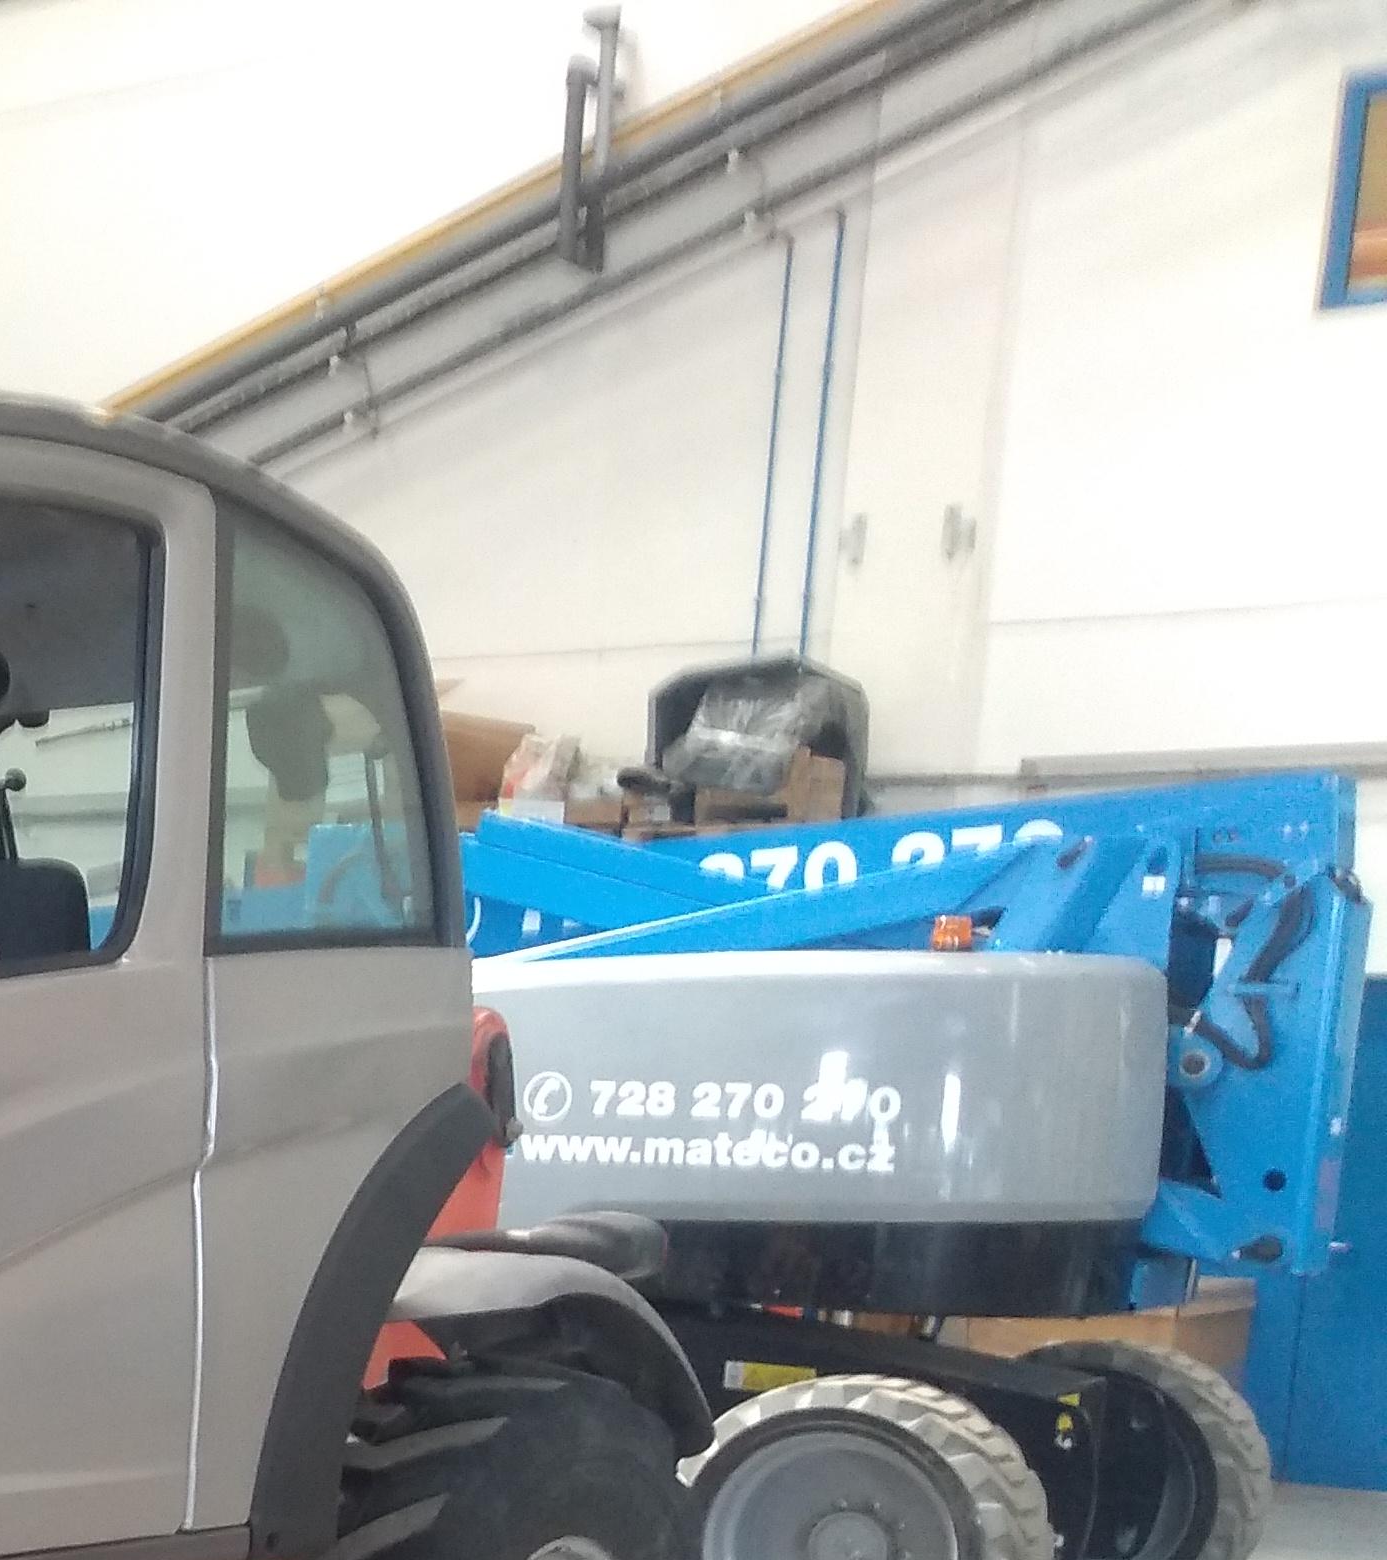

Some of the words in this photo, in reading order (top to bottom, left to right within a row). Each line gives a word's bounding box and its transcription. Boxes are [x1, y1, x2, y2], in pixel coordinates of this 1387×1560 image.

[589, 1080, 677, 1118] 728
[690, 1081, 786, 1120] 270
[520, 1130, 896, 1174] www.mateco.cz
